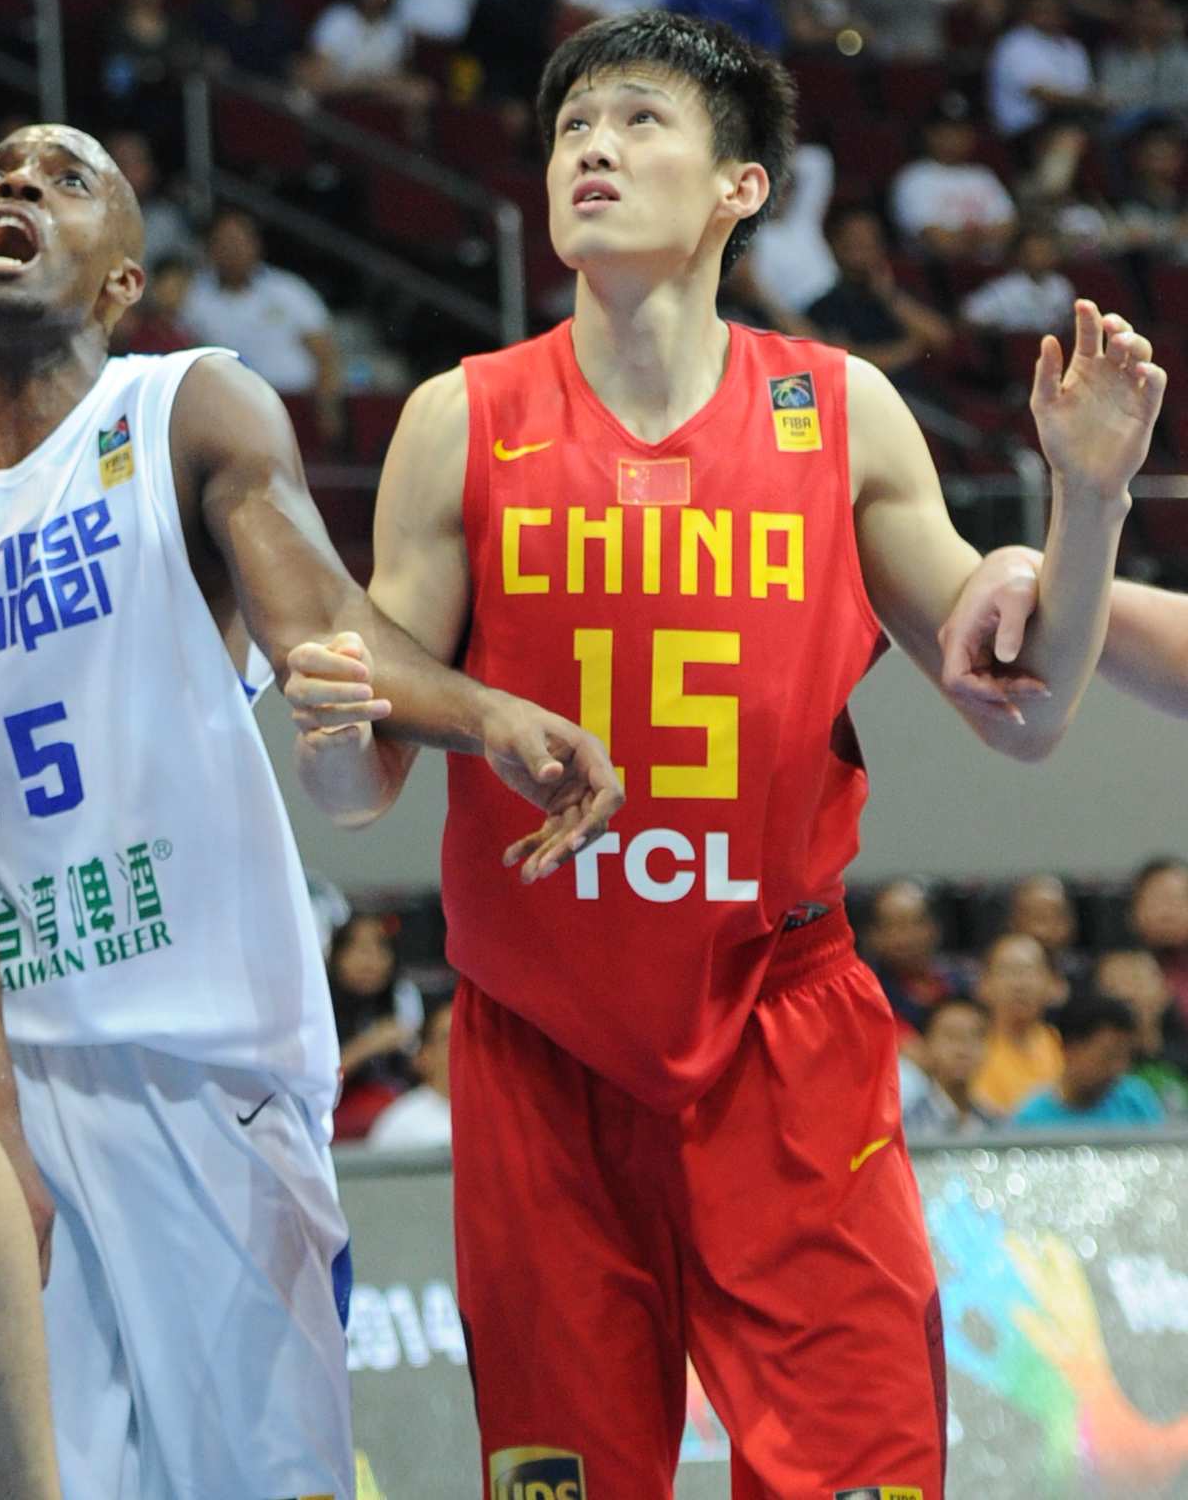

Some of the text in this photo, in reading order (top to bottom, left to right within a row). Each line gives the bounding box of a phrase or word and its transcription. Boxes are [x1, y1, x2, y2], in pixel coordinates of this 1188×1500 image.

[502, 507, 804, 601] CHINA
[4, 701, 85, 819] 5
[574, 628, 740, 800] 15
[575, 828, 759, 902] TCL
[0, 921, 173, 991] AIWAN BEER
